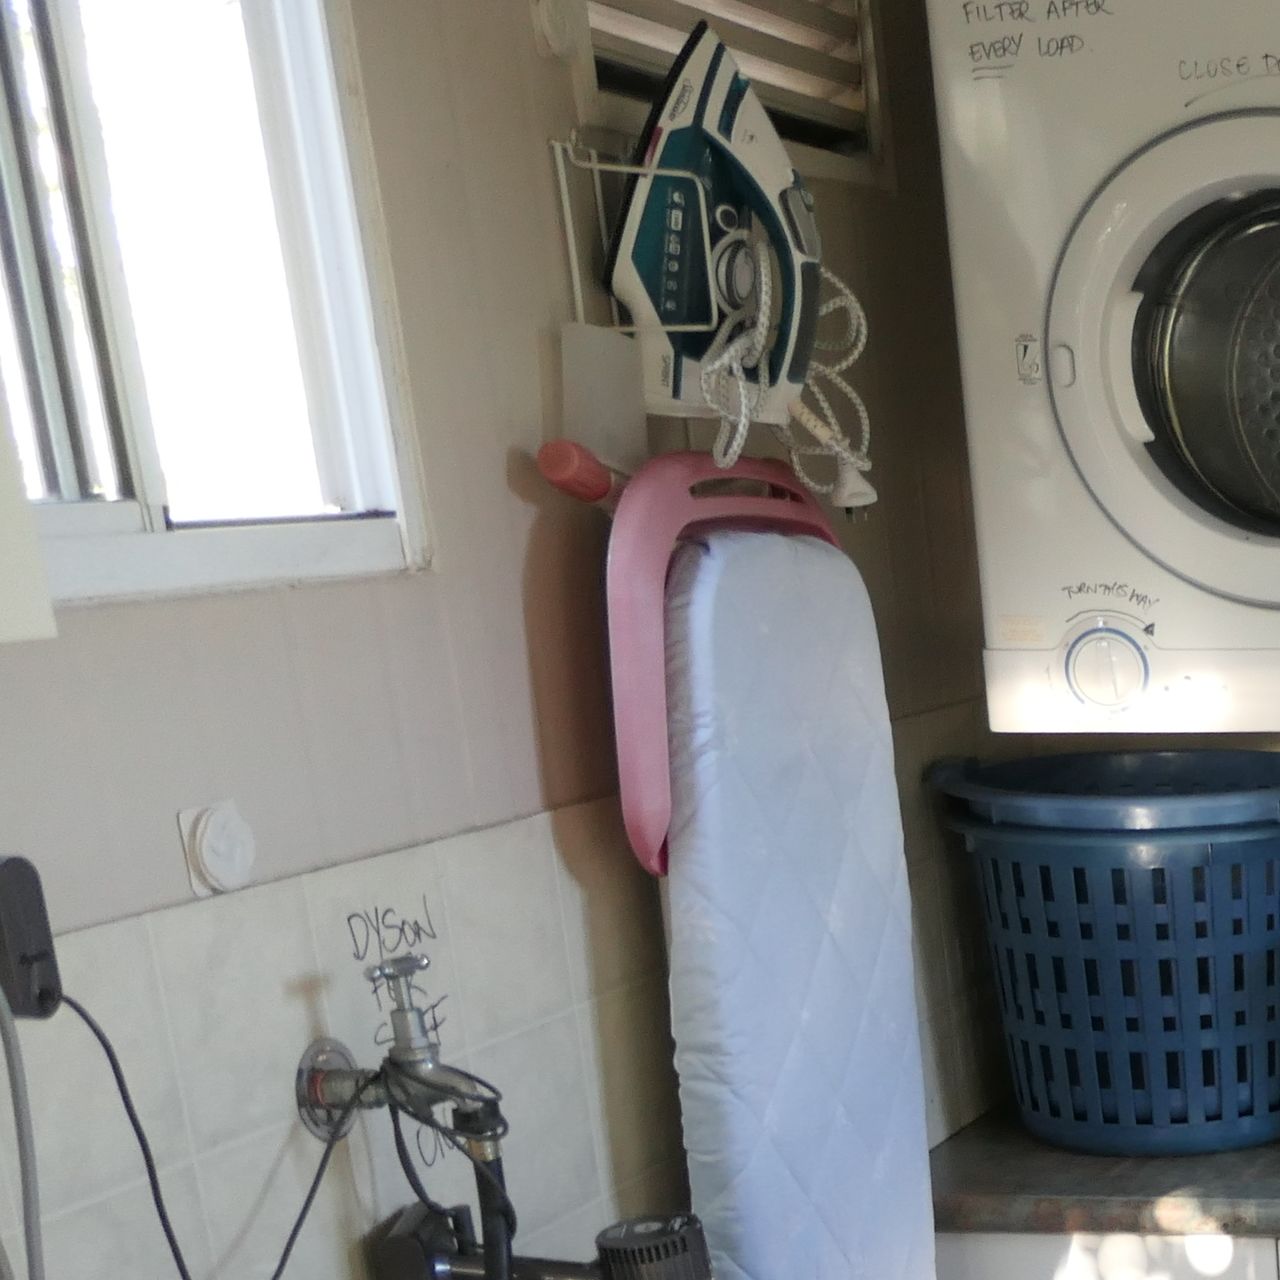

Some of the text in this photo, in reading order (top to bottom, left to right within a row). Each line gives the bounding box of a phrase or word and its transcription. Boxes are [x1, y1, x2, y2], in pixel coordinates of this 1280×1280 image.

[963, 1, 1035, 24] FILTER
[969, 33, 1023, 62] EVERY
[1179, 55, 1250, 81] CLOSE
[1062, 582, 1097, 599] TURN
[347, 894, 437, 962] DYSON
